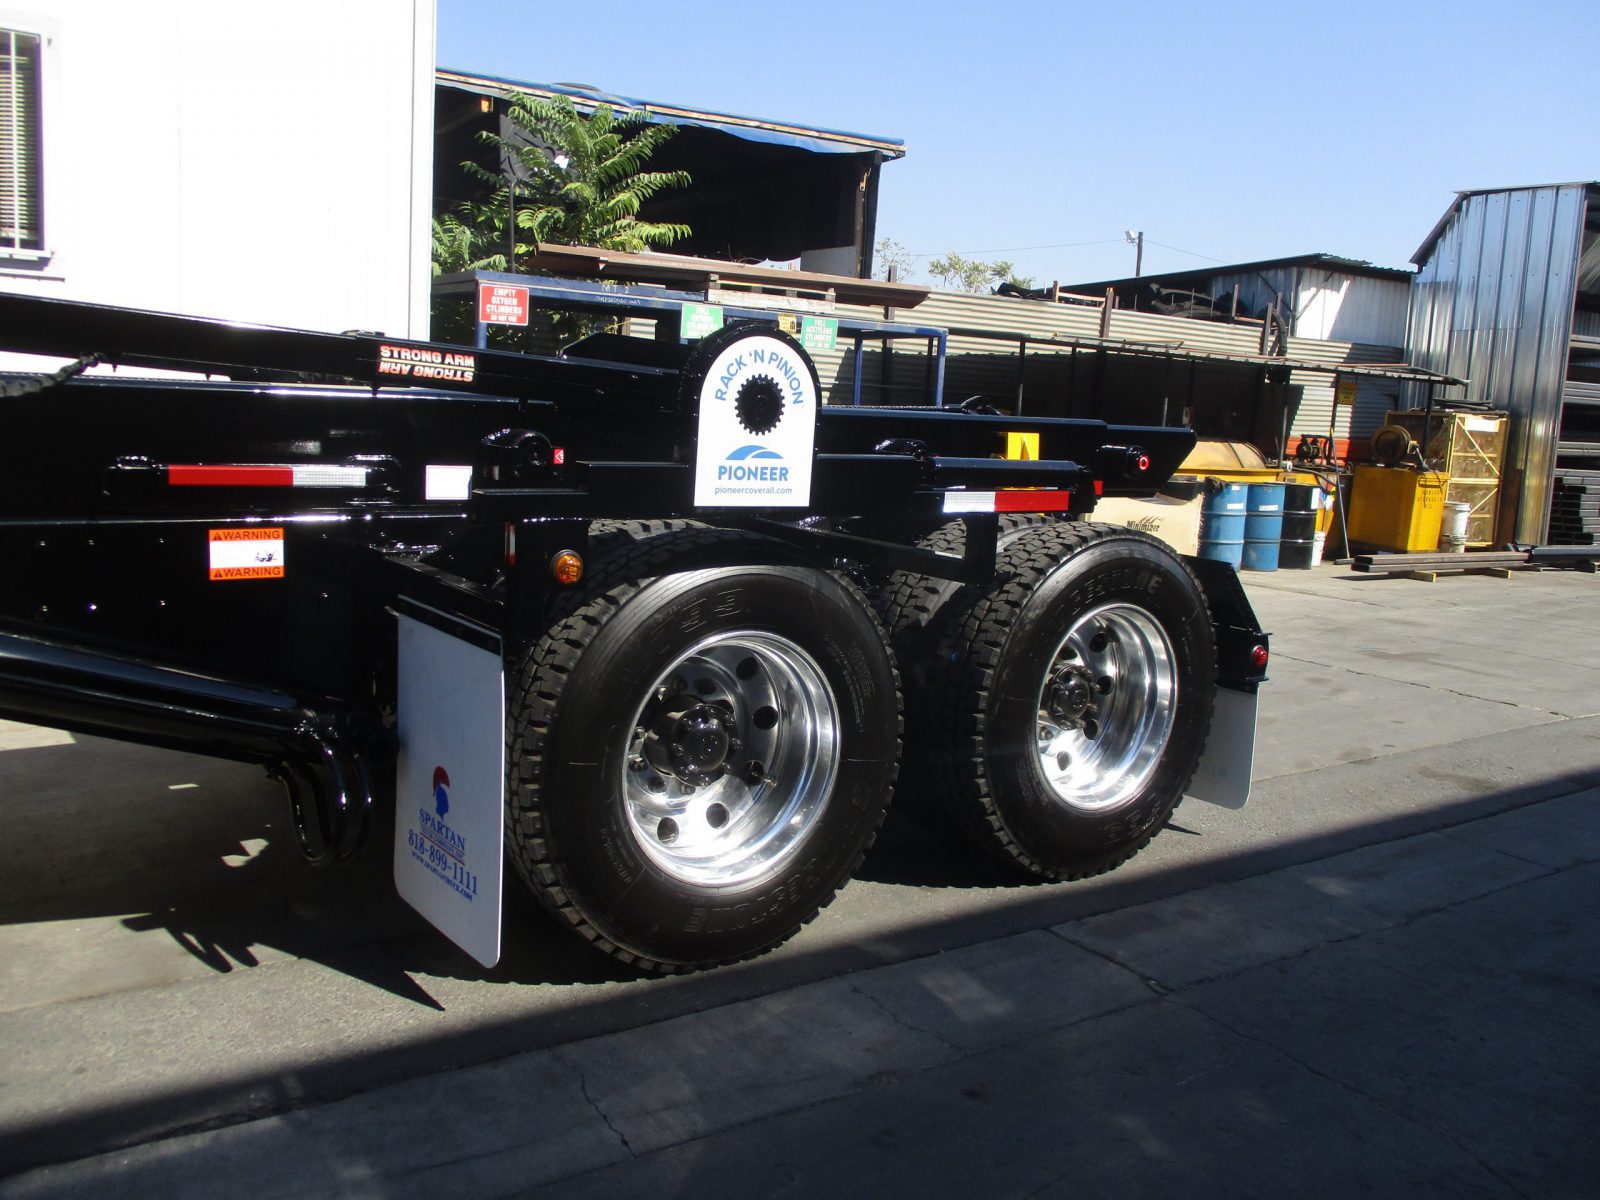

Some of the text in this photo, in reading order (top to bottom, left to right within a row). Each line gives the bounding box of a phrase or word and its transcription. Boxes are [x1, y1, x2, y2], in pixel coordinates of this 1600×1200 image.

[494, 288, 516, 297] EMPTY
[491, 296, 518, 306] OXYGEN
[486, 304, 523, 314] CYLINDERS
[380, 345, 475, 367] STRONG ARM
[378, 361, 474, 382] STRONG ARM
[715, 355, 747, 401] RACK
[768, 351, 804, 405] PINION
[718, 465, 789, 482] PIONEER
[714, 486, 793, 495] pioneercoverall.com
[1127, 520, 1160, 532] Minimizer
[222, 530, 280, 540] WARNING
[223, 566, 281, 578] WARNING
[419, 808, 466, 852] SPARTAN
[408, 828, 478, 896] 818-899-1111
